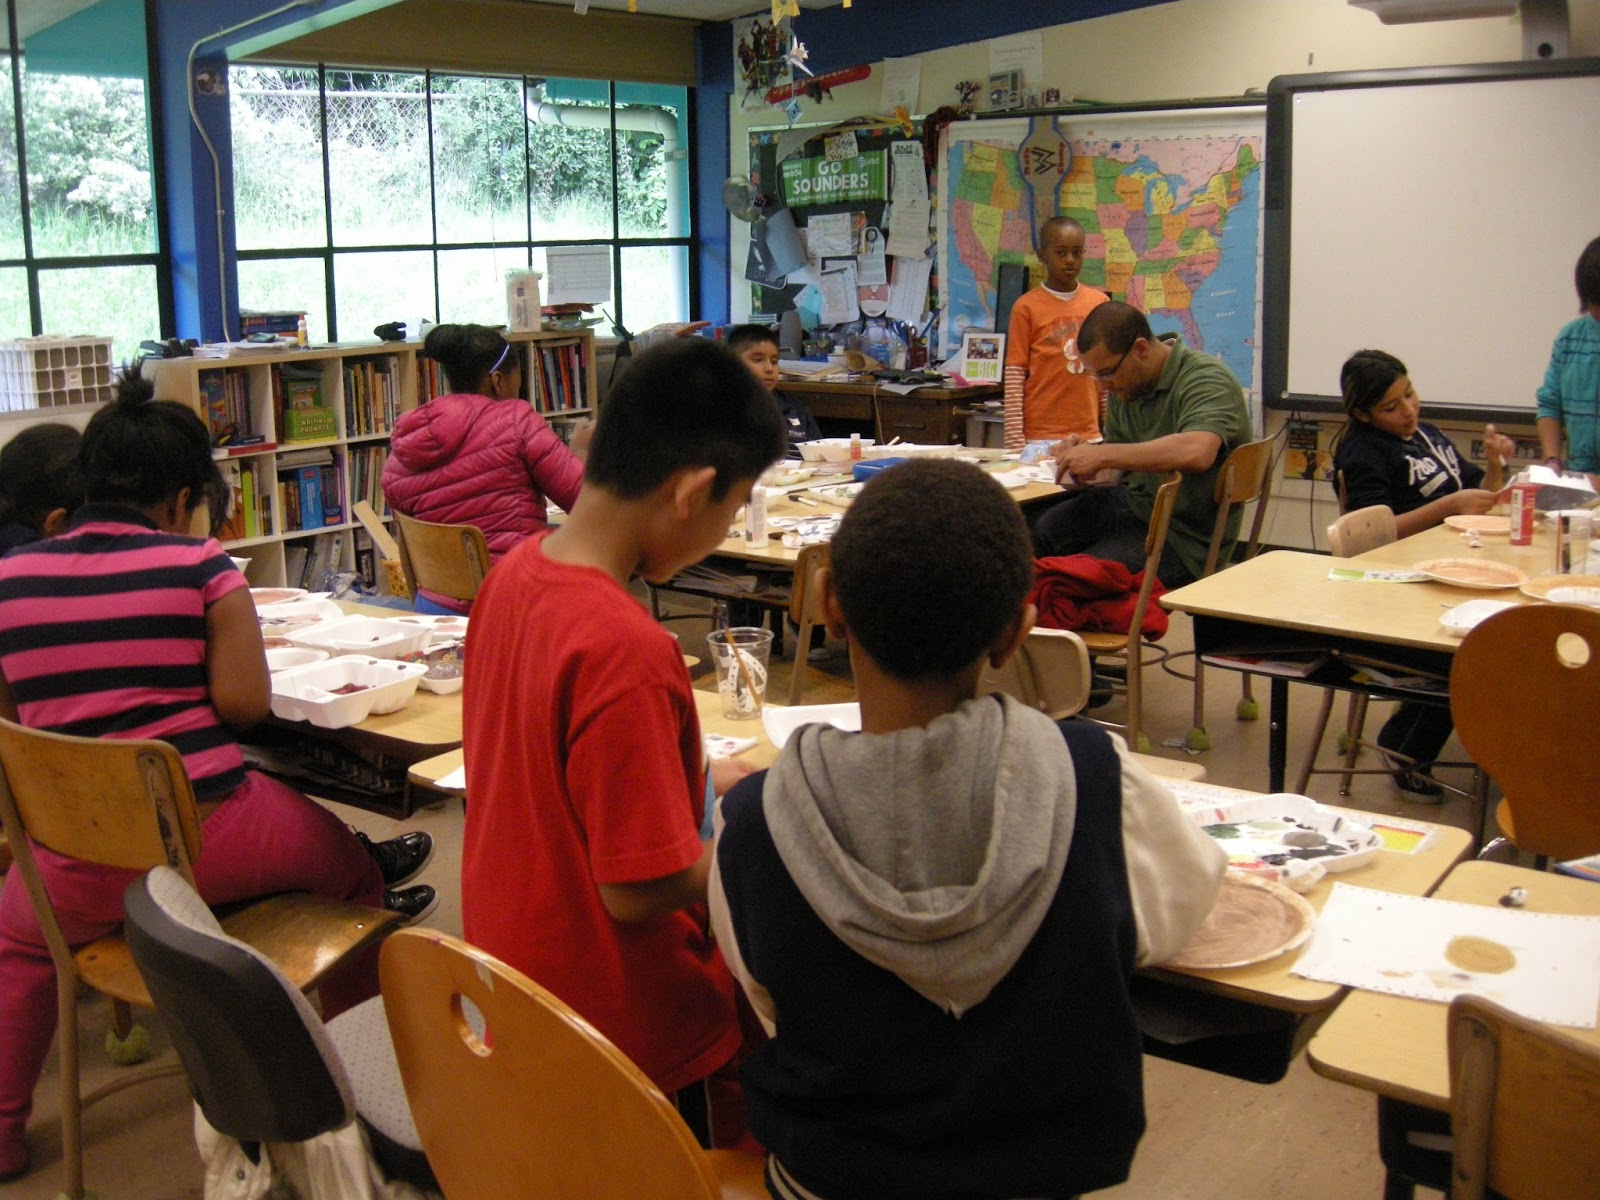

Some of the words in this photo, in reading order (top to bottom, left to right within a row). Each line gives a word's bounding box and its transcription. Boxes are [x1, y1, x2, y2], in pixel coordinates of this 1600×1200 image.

[818, 161, 842, 176] GO
[793, 173, 868, 195] SOUNDERS
[1216, 310, 1237, 318] Ocean
[301, 417, 326, 426] WRITING
[300, 425, 330, 433] PROMPTS
